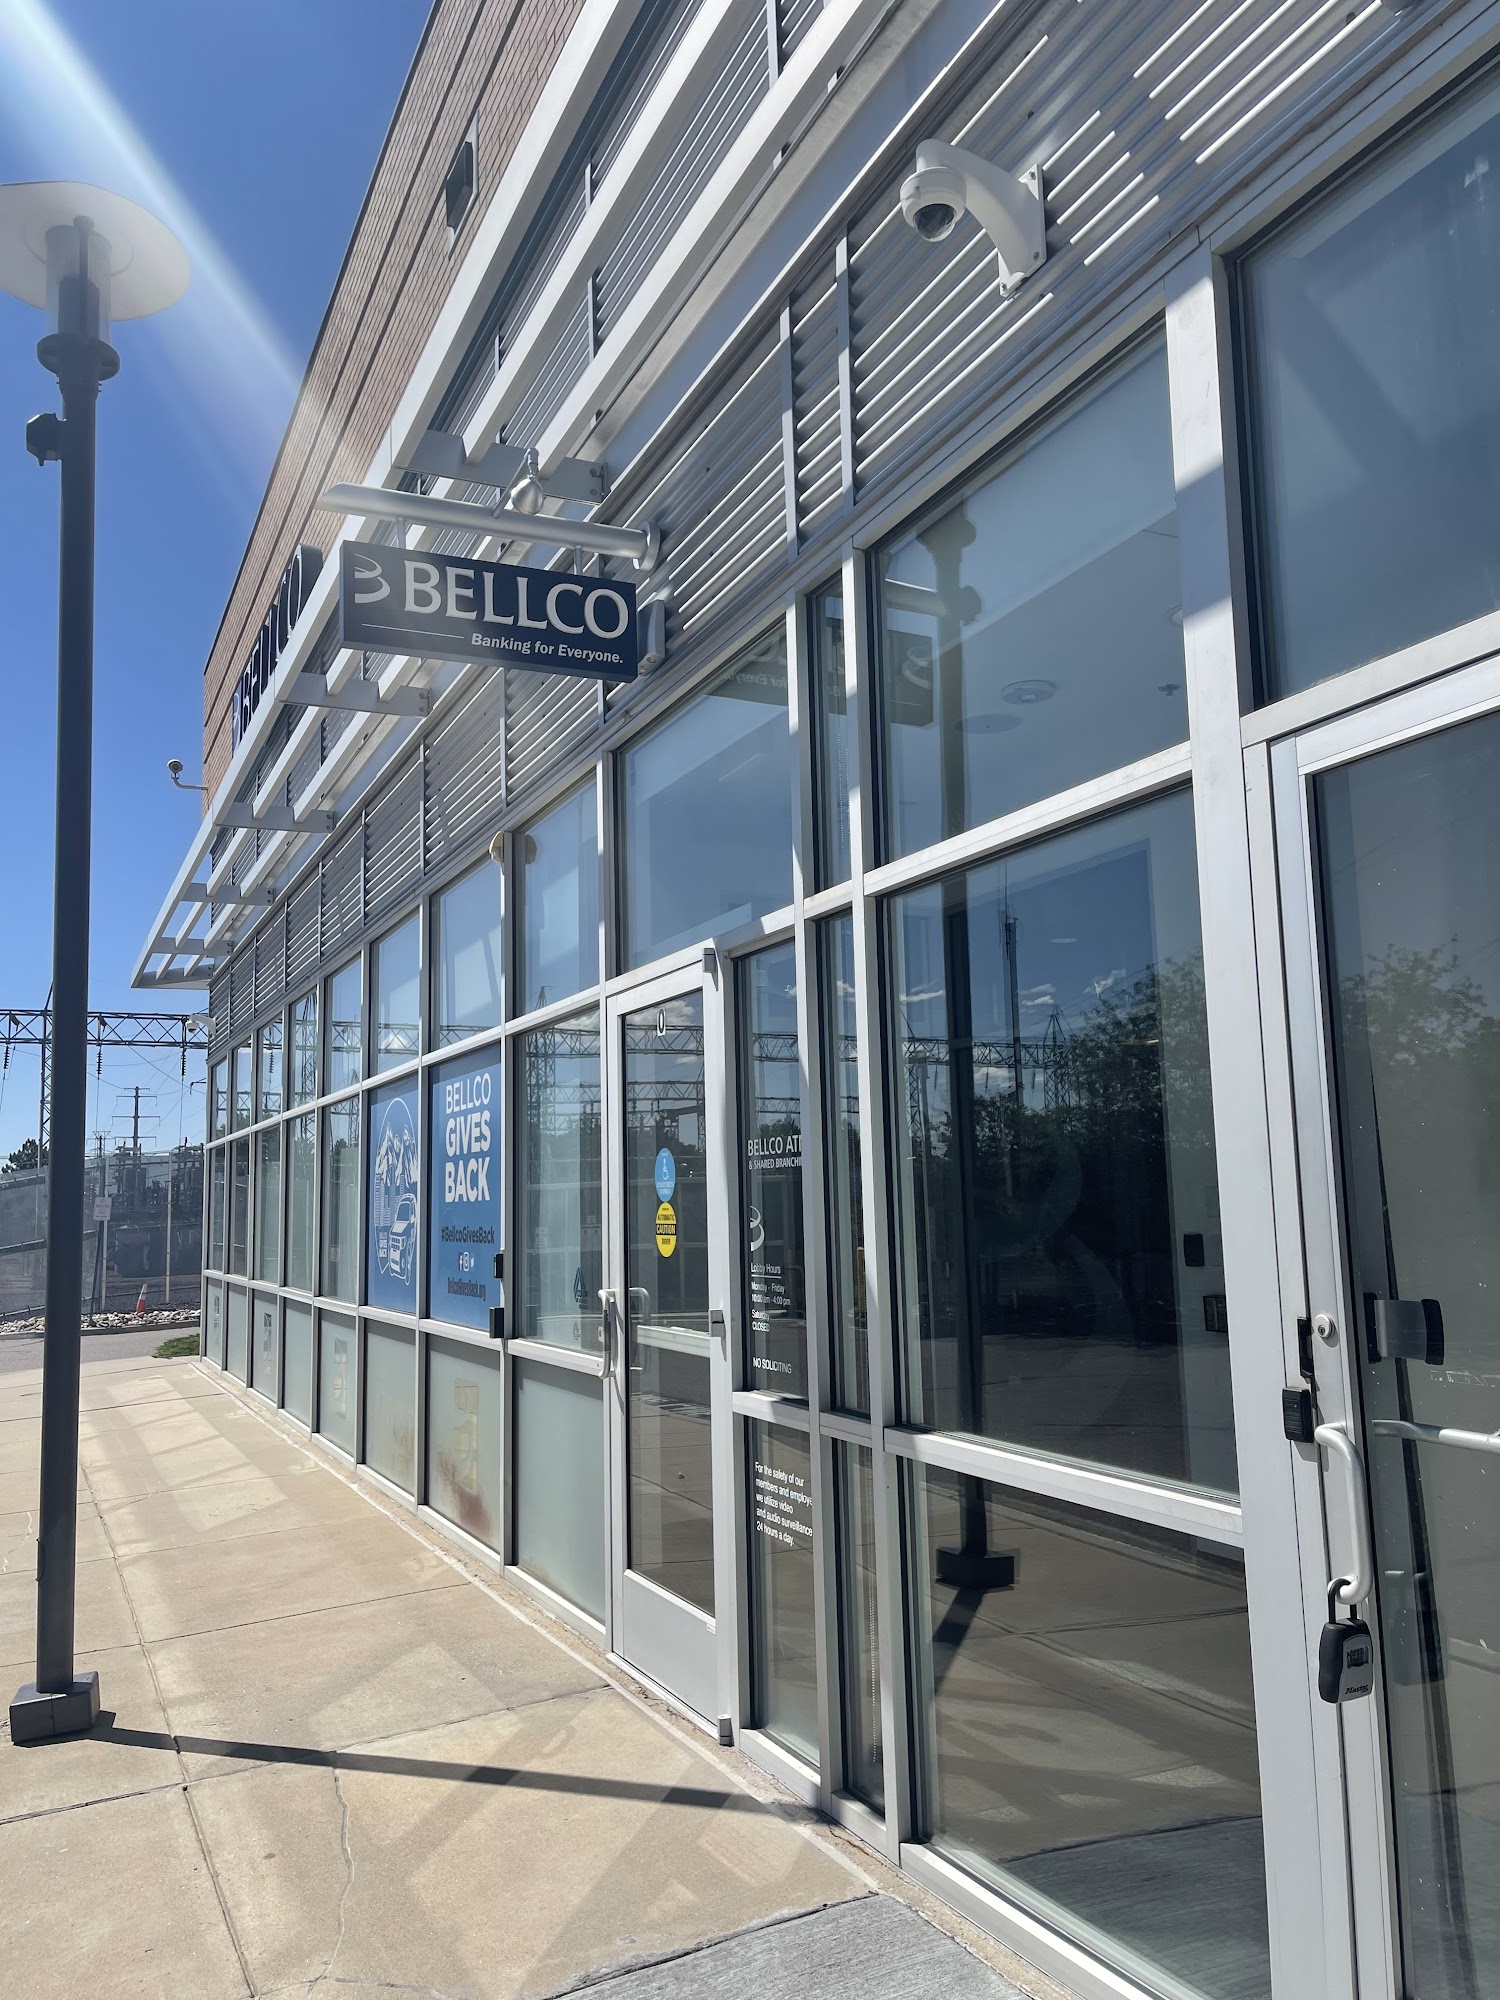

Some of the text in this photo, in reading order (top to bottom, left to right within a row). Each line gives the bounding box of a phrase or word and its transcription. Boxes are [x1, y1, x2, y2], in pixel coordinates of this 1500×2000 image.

[404, 559, 629, 639] BELLCO
[471, 633, 624, 664] Banking for Everyone.
[446, 1072, 492, 1115] BELLCO
[445, 1109, 491, 1157] GIVES
[748, 1134, 801, 1157] BELLCO AT
[749, 1156, 801, 1170] & SHARED BRANCHI
[445, 1156, 490, 1203] BACK
[441, 1226, 495, 1244] #BellcoGivesBack
[656, 1224, 676, 1235] CAUTION
[661, 1237, 671, 1245] DOOR
[751, 1262, 782, 1275] Lobby Hours
[771, 1282, 785, 1295] Friday
[751, 1321, 771, 1332] CLOSED
[752, 1356, 792, 1374] NO SOLICITING
[755, 1461, 805, 1488] For the safety of our
[755, 1478, 778, 1494] members
[778, 1486, 790, 1498] and
[755, 1493, 764, 1503] we
[778, 1500, 794, 1514] video
[756, 1507, 813, 1537] and audio surveillance
[756, 1520, 763, 1531] 24
[763, 1522, 778, 1539] hours
[778, 1531, 783, 1540] a
